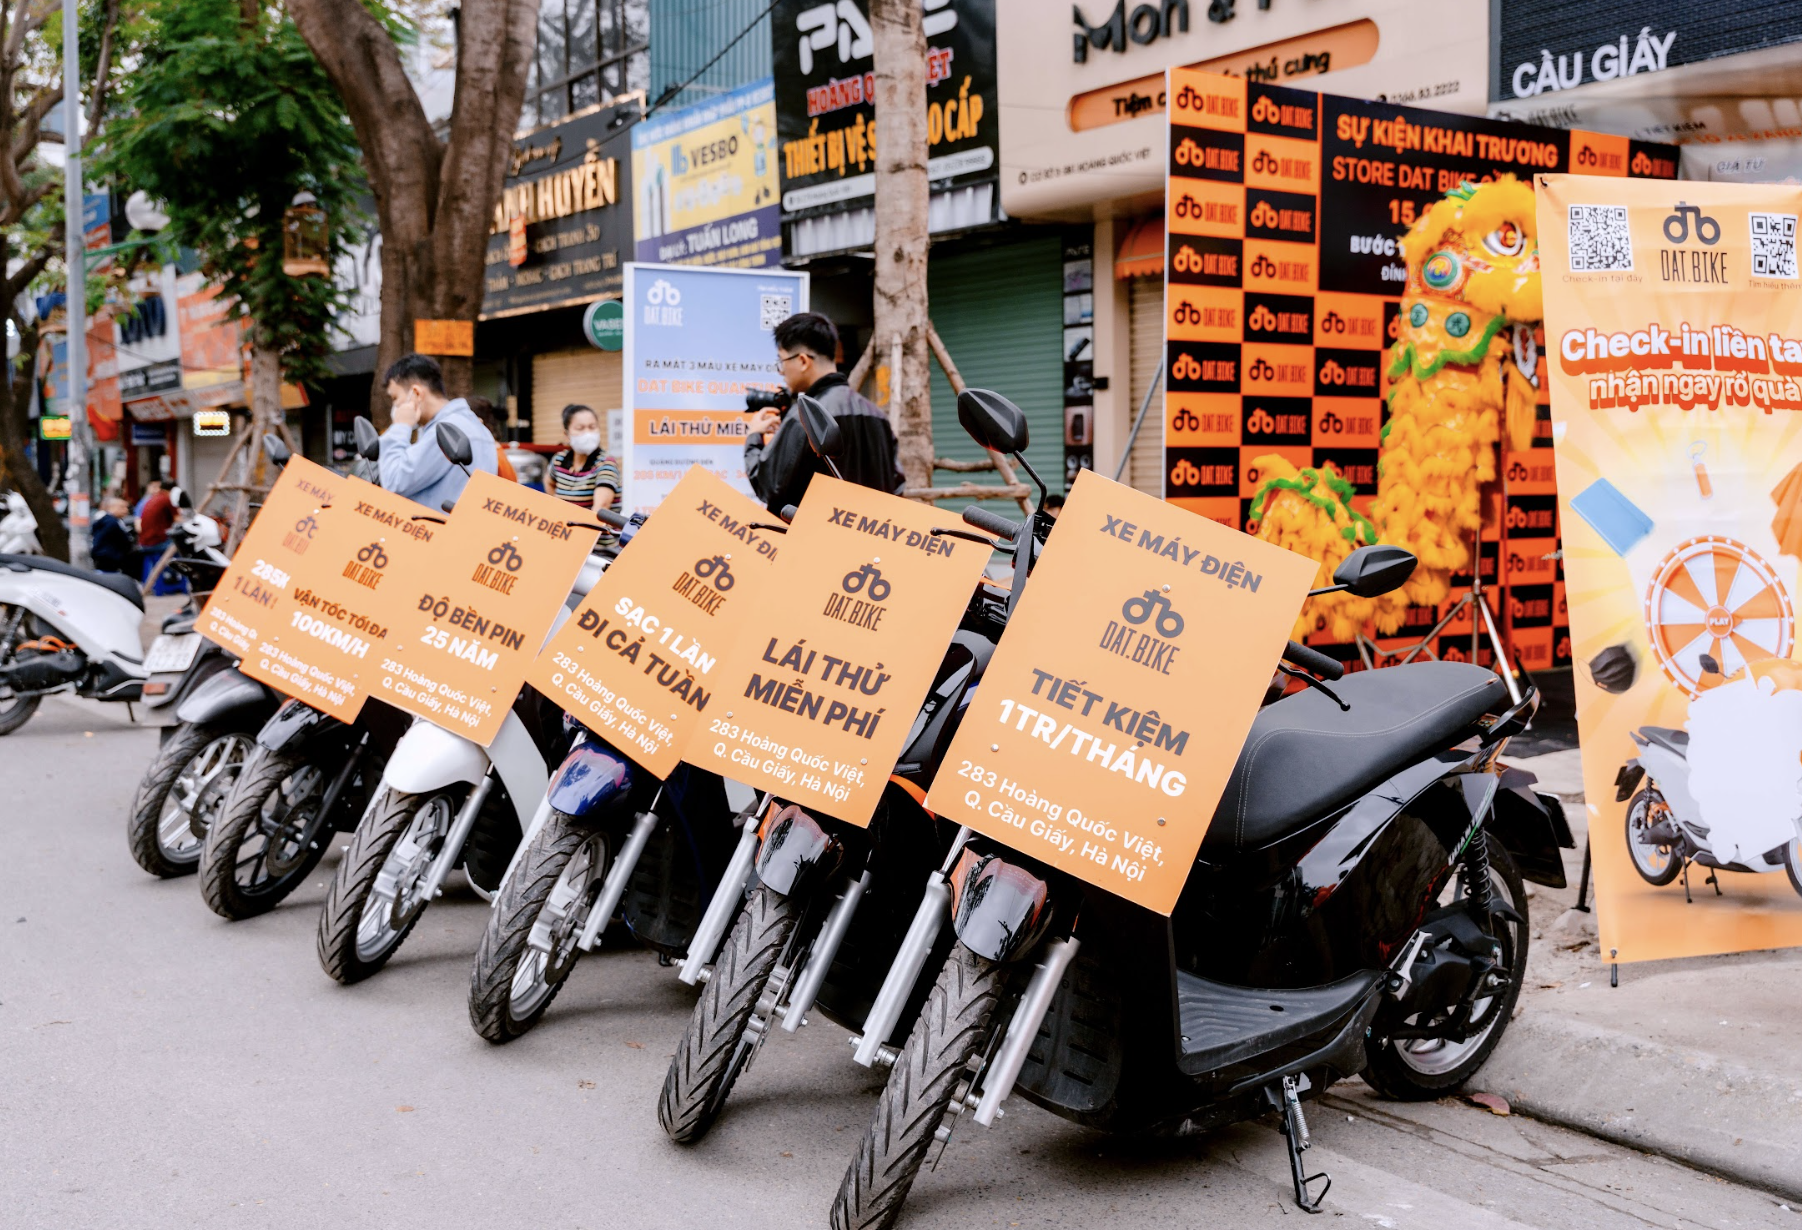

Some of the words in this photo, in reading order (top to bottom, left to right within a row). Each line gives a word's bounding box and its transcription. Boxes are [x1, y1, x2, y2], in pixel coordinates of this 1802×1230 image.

[1112, 91, 1152, 119] Tiệm
[1284, 50, 1332, 74] cưng
[1512, 49, 1582, 98] CẦU
[1590, 26, 1678, 82] GIẤY
[806, 75, 863, 117] HOÀNG
[943, 74, 984, 144] CẤP
[690, 135, 739, 169] VESBO
[783, 116, 827, 180] THIẾT
[826, 129, 846, 177] BỊ
[844, 112, 867, 173] VỆ
[1336, 113, 1371, 149] SỰ
[1372, 114, 1422, 155] KIỆN
[1423, 128, 1474, 157] KHAI
[1475, 133, 1559, 169] TRƯƠNG
[1332, 155, 1396, 187] STORE
[1398, 162, 1435, 191] DAT
[722, 216, 759, 246] LONG
[1562, 273, 1608, 284] Check-in
[1661, 249, 1729, 285] DAT.BIKE
[643, 305, 684, 327] DAT.BIKE
[1560, 322, 1711, 368] Check-in
[1712, 324, 1768, 370] liền
[1769, 333, 1802, 370] ta
[637, 378, 669, 393] DAT
[671, 379, 705, 395] BIKE
[1589, 370, 1659, 408] nhận
[1663, 372, 1722, 408] ngay
[1724, 370, 1750, 403] rổ
[1753, 373, 1802, 408] quà
[650, 416, 676, 436] LÁI
[679, 416, 714, 436] THỬ
[354, 500, 374, 518] XE
[372, 507, 405, 531] MÁY
[402, 518, 434, 543] ĐIỆN
[482, 497, 505, 516] XE
[503, 503, 540, 528] MÁY
[536, 516, 574, 542] ĐIỆN
[696, 498, 723, 524] XE
[718, 514, 761, 546] MÁY
[755, 539, 779, 566] ĐI
[827, 506, 858, 530] XE
[855, 513, 906, 543] MÁY
[905, 529, 956, 559] ĐIỆN
[342, 559, 385, 590] DAT.BIKE
[471, 562, 519, 596] DAT.BIKE
[1099, 514, 1137, 544] XE
[1138, 523, 1202, 567] MÁY
[1200, 554, 1263, 594] ĐIỆN
[293, 586, 324, 611] VẬN
[320, 597, 350, 621] TỐC
[349, 610, 372, 633] TỐI
[367, 622, 389, 641] ĐA
[671, 571, 727, 617] DAT.BIKE
[822, 591, 887, 632] DAT.BIKE
[225, 612, 250, 636] Hoàng
[290, 610, 371, 660] 100KM/H
[417, 592, 451, 619] ĐỘ
[449, 605, 491, 638] BỀN
[490, 623, 526, 651] PIN
[419, 625, 447, 651] 25
[447, 633, 500, 672] NĂM
[614, 596, 661, 636] SẠC
[659, 626, 677, 650] 1
[669, 635, 717, 675] LẦN
[1098, 620, 1181, 676] DAT.BIKE
[1708, 616, 1730, 627] PLAY
[258, 641, 280, 660] 283
[278, 650, 309, 677] Hoàng
[309, 664, 335, 687] Quốc
[334, 673, 356, 697] Việt,
[259, 658, 270, 672] Q.
[269, 663, 292, 683] Cầu
[290, 672, 315, 695] Giấy,
[314, 683, 330, 699] Hà
[328, 690, 345, 707] Nội
[576, 607, 602, 640] ĐI
[603, 628, 647, 666] CẢ
[644, 652, 712, 713] TUẦN
[761, 636, 819, 676] LÁI
[820, 655, 892, 697] THỬ
[381, 657, 403, 677] 283
[402, 667, 437, 694] Hoàng
[437, 679, 466, 704] Quốc
[466, 692, 492, 718] Việt,
[381, 676, 393, 690] Q.
[392, 681, 417, 702] Cầu
[416, 690, 443, 713] Giấy,
[443, 702, 461, 718] Hà
[460, 708, 482, 728] Nội
[551, 672, 565, 689] Q.
[565, 676, 592, 705] Cầu
[588, 696, 619, 730] Giấy,
[616, 718, 637, 739] Hà
[635, 728, 659, 755] Nội
[552, 651, 579, 675] 283
[575, 665, 615, 705] Hoàng
[613, 691, 647, 722] Quốc
[647, 715, 675, 748] Việt,
[743, 673, 828, 723] MIỄN
[823, 705, 887, 741] PHÍ
[1031, 667, 1104, 713] TIẾT
[1102, 705, 1191, 757] KIỆM
[709, 718, 739, 741] 283
[738, 729, 788, 760] Hoàng
[789, 748, 830, 776] Quốc
[831, 761, 866, 789] Việt,
[712, 742, 728, 760] Q.
[729, 747, 761, 772] Cầu
[761, 757, 798, 787] Giấy,
[798, 773, 822, 793] Hà
[822, 778, 852, 803] Nội
[998, 698, 1188, 798] 1TR/THÁNG
[957, 758, 998, 788] 283
[999, 776, 1063, 820] Hoàng
[1065, 806, 1119, 844] Quốc
[1122, 828, 1165, 868] Việt,
[963, 790, 983, 813] Q.
[986, 799, 1028, 833] Cầu
[1030, 815, 1076, 857] Giấy,
[1079, 840, 1109, 868] Hà
[1110, 852, 1146, 883] Nội
